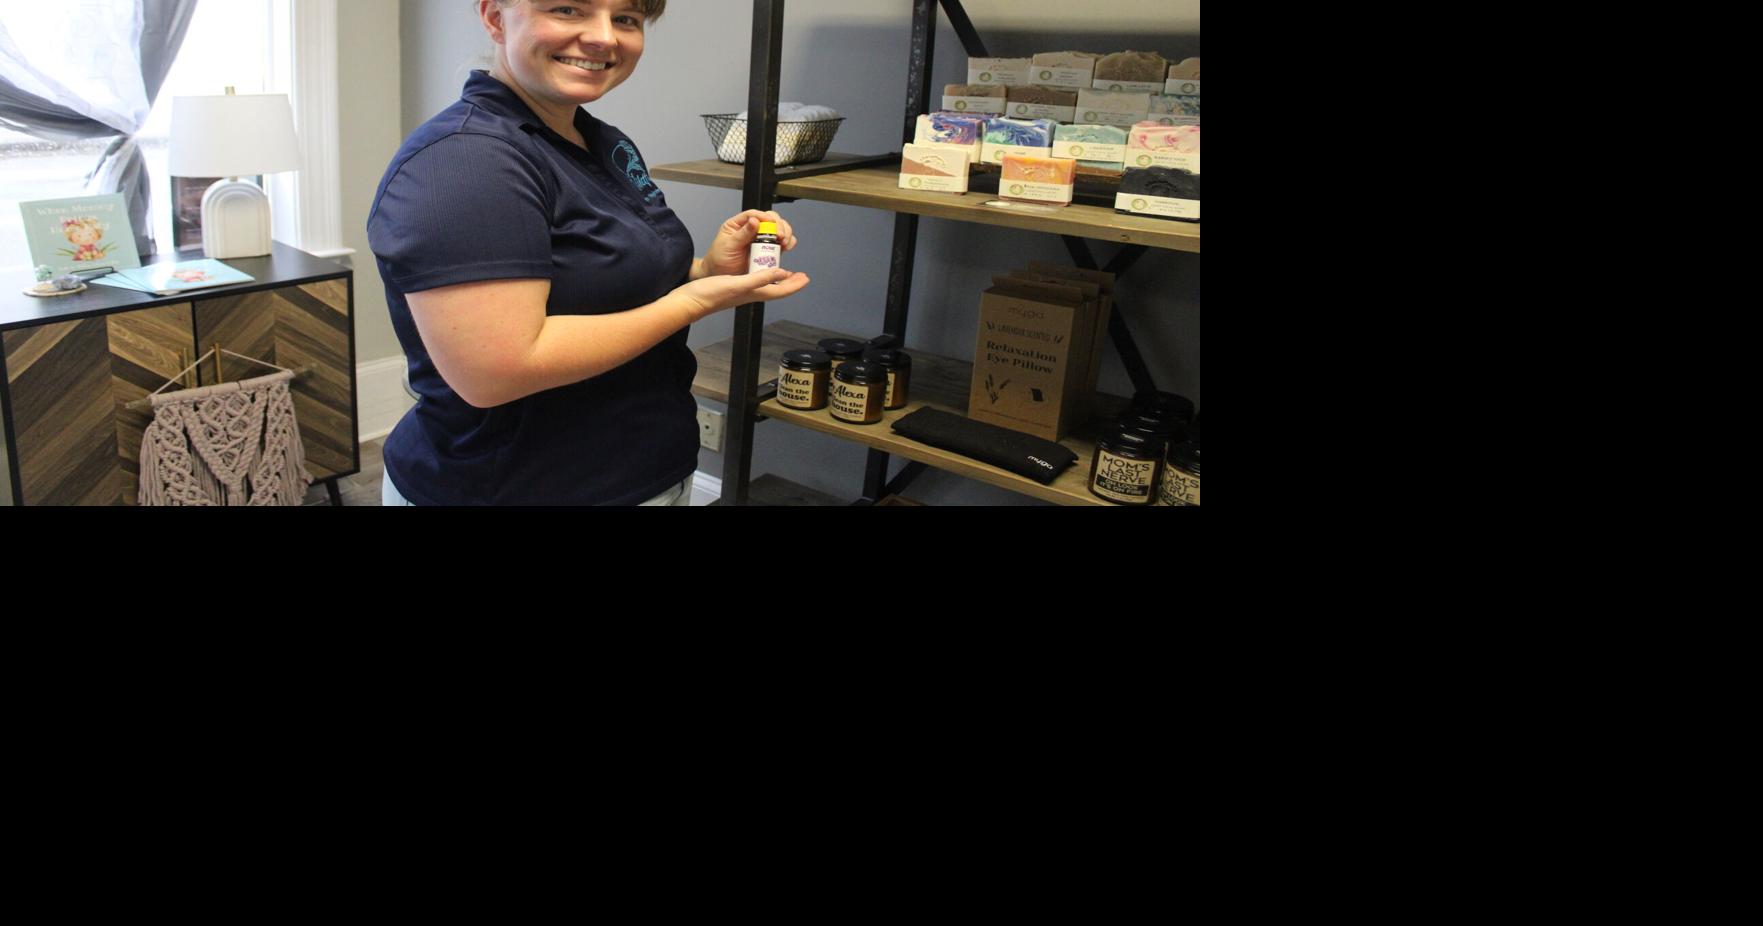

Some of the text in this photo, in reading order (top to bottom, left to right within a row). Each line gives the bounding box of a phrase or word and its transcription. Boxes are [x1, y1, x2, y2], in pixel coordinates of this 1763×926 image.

[987, 341, 1056, 362] Relaxation
[987, 353, 1054, 374] Eye Pillow
[781, 373, 810, 386] Alexa
[835, 385, 865, 400] Alexa
[1103, 455, 1150, 472] MOM'S
[1107, 463, 1143, 479] LAST
[1101, 470, 1146, 485] NERVE
[1166, 478, 1189, 493] AST
